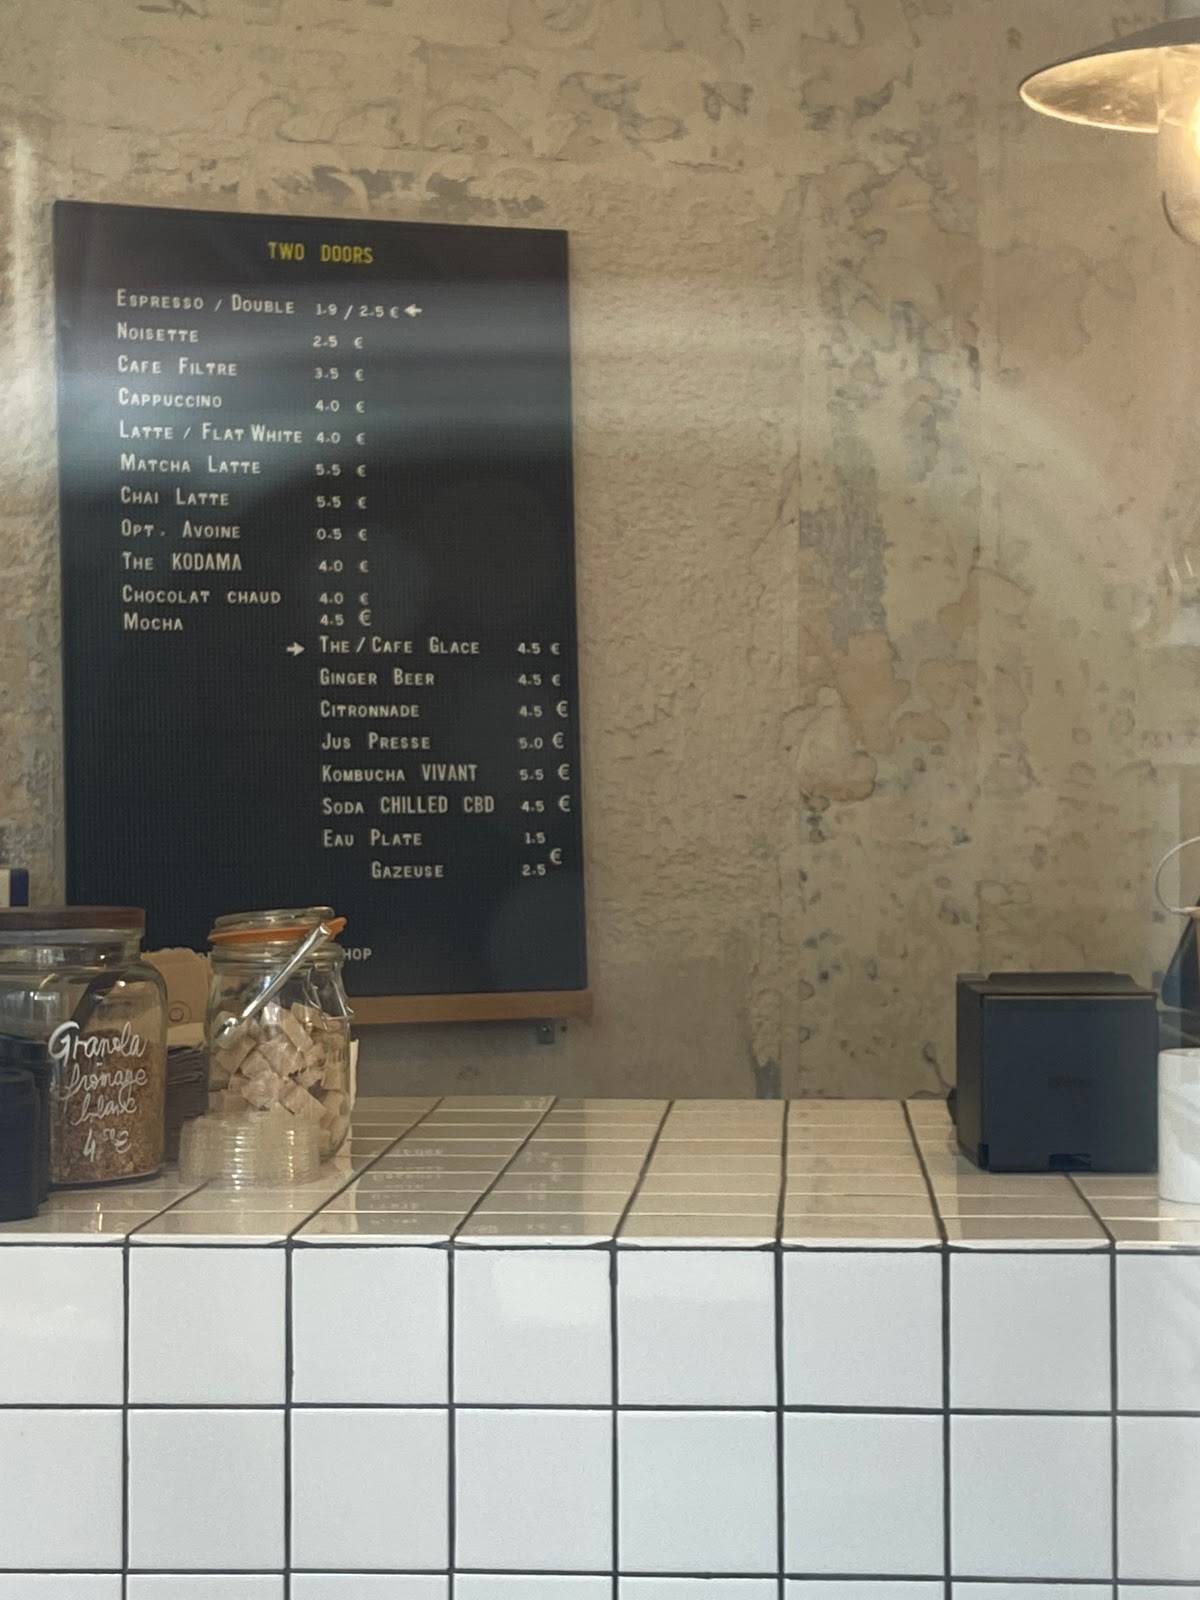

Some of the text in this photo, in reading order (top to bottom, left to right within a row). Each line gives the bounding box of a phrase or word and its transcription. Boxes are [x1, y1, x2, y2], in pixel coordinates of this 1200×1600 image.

[267, 241, 375, 265] TWO DOORS
[116, 288, 204, 310] ESPRESSO
[231, 293, 296, 315] DOUBLE
[316, 303, 338, 317] 1.9
[358, 304, 385, 319] 2.5
[389, 305, 400, 319] €
[116, 321, 364, 350] NOISETTE 2.5 €
[117, 354, 365, 382] CAFE FILTRE 3.5 €
[118, 387, 366, 414] CAPPUCCINO 4.0 €
[119, 419, 174, 440] LATTE
[201, 421, 245, 442] FLAT
[250, 423, 303, 445] WHITE
[315, 431, 341, 445] 4.0
[355, 432, 366, 446] €
[120, 452, 367, 478] MATCHA LATTE 5.5 €
[120, 485, 367, 510] CHAI LATTE 5.5 €
[181, 519, 241, 540] AVOINE
[316, 527, 343, 541] 0.5
[357, 528, 368, 542] €
[121, 550, 369, 574] THE KODAMA 4.0 €
[121, 583, 369, 606] CHOCOLAT CHAUD 4.0 €
[123, 608, 372, 632] MOCHA 4.5 €
[428, 635, 481, 655] GLACE
[516, 642, 541, 656] 4.5
[549, 642, 561, 656] €
[319, 667, 562, 687] GINGER BEER 4.5 €
[319, 699, 569, 719] CITRONNADE 4.5 €
[321, 731, 565, 751] JUS PRESSE 5.0 €
[321, 763, 571, 783] KOMBUCHA VIVANT 5.5 €
[321, 794, 572, 816] SODA CHILLED CBD 4.5 €
[323, 828, 546, 848] EAU PLATE 1.5
[549, 847, 563, 866] €
[371, 860, 546, 880] GAZEUSE 2.5
[47, 1020, 148, 1067] Granola
[59, 1062, 149, 1113] fromage
